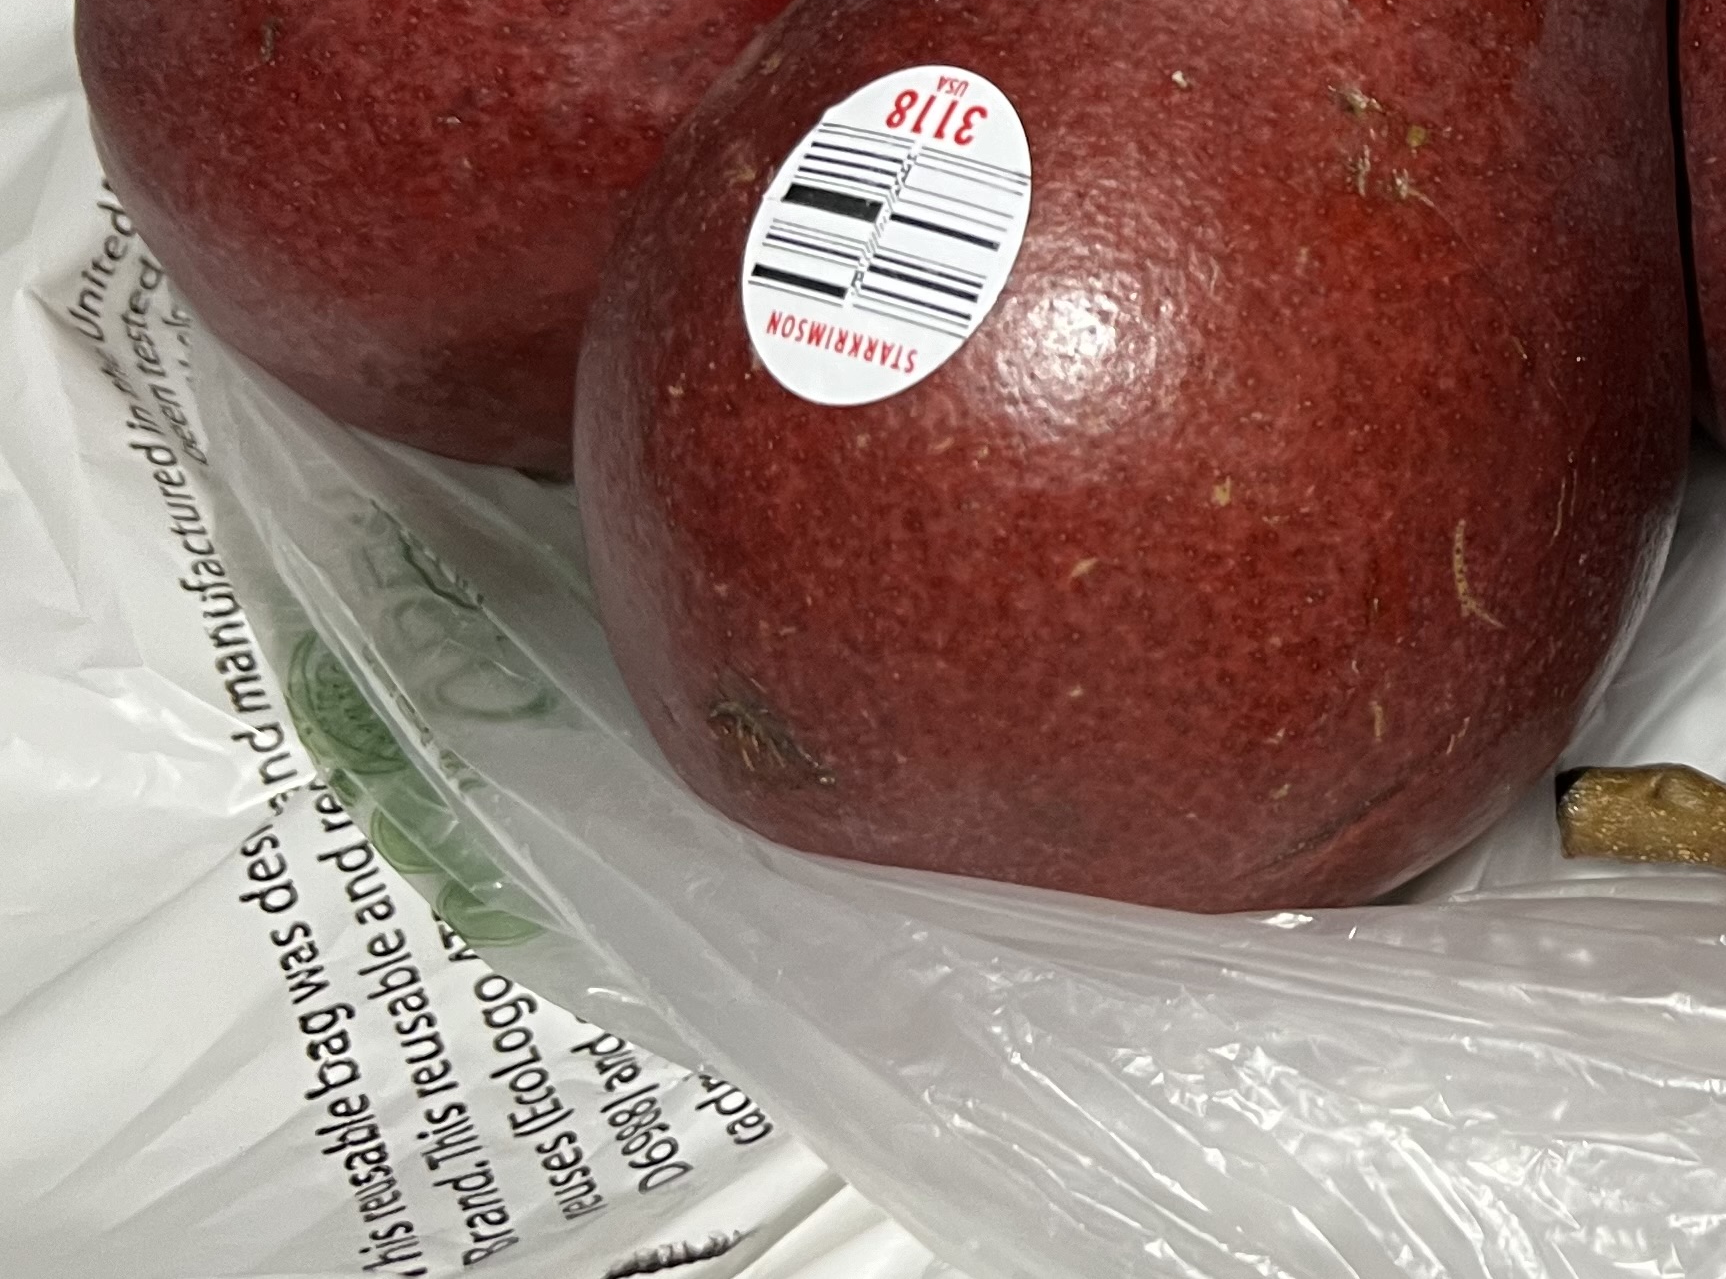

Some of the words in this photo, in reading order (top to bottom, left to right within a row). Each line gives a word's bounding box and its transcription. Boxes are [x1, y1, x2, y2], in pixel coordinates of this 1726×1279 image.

[885, 88, 989, 146] 3118
[937, 75, 969, 98] USA
[67, 200, 136, 343] United
[121, 255, 167, 377] tested
[766, 309, 918, 374] STARKRIMSON
[126, 404, 165, 436] in
[128, 441, 272, 715] manufactured
[316, 839, 396, 925] and
[269, 921, 330, 1005] was
[298, 1002, 361, 1100] bag
[356, 928, 460, 1099] reusable
[473, 972, 575, 1139] (EcoLogo
[570, 1032, 643, 1092] and
[314, 1093, 407, 1223] reusable
[416, 1102, 484, 1171] This
[534, 1130, 608, 1221] reuses
[432, 1159, 520, 1266] Brand.
